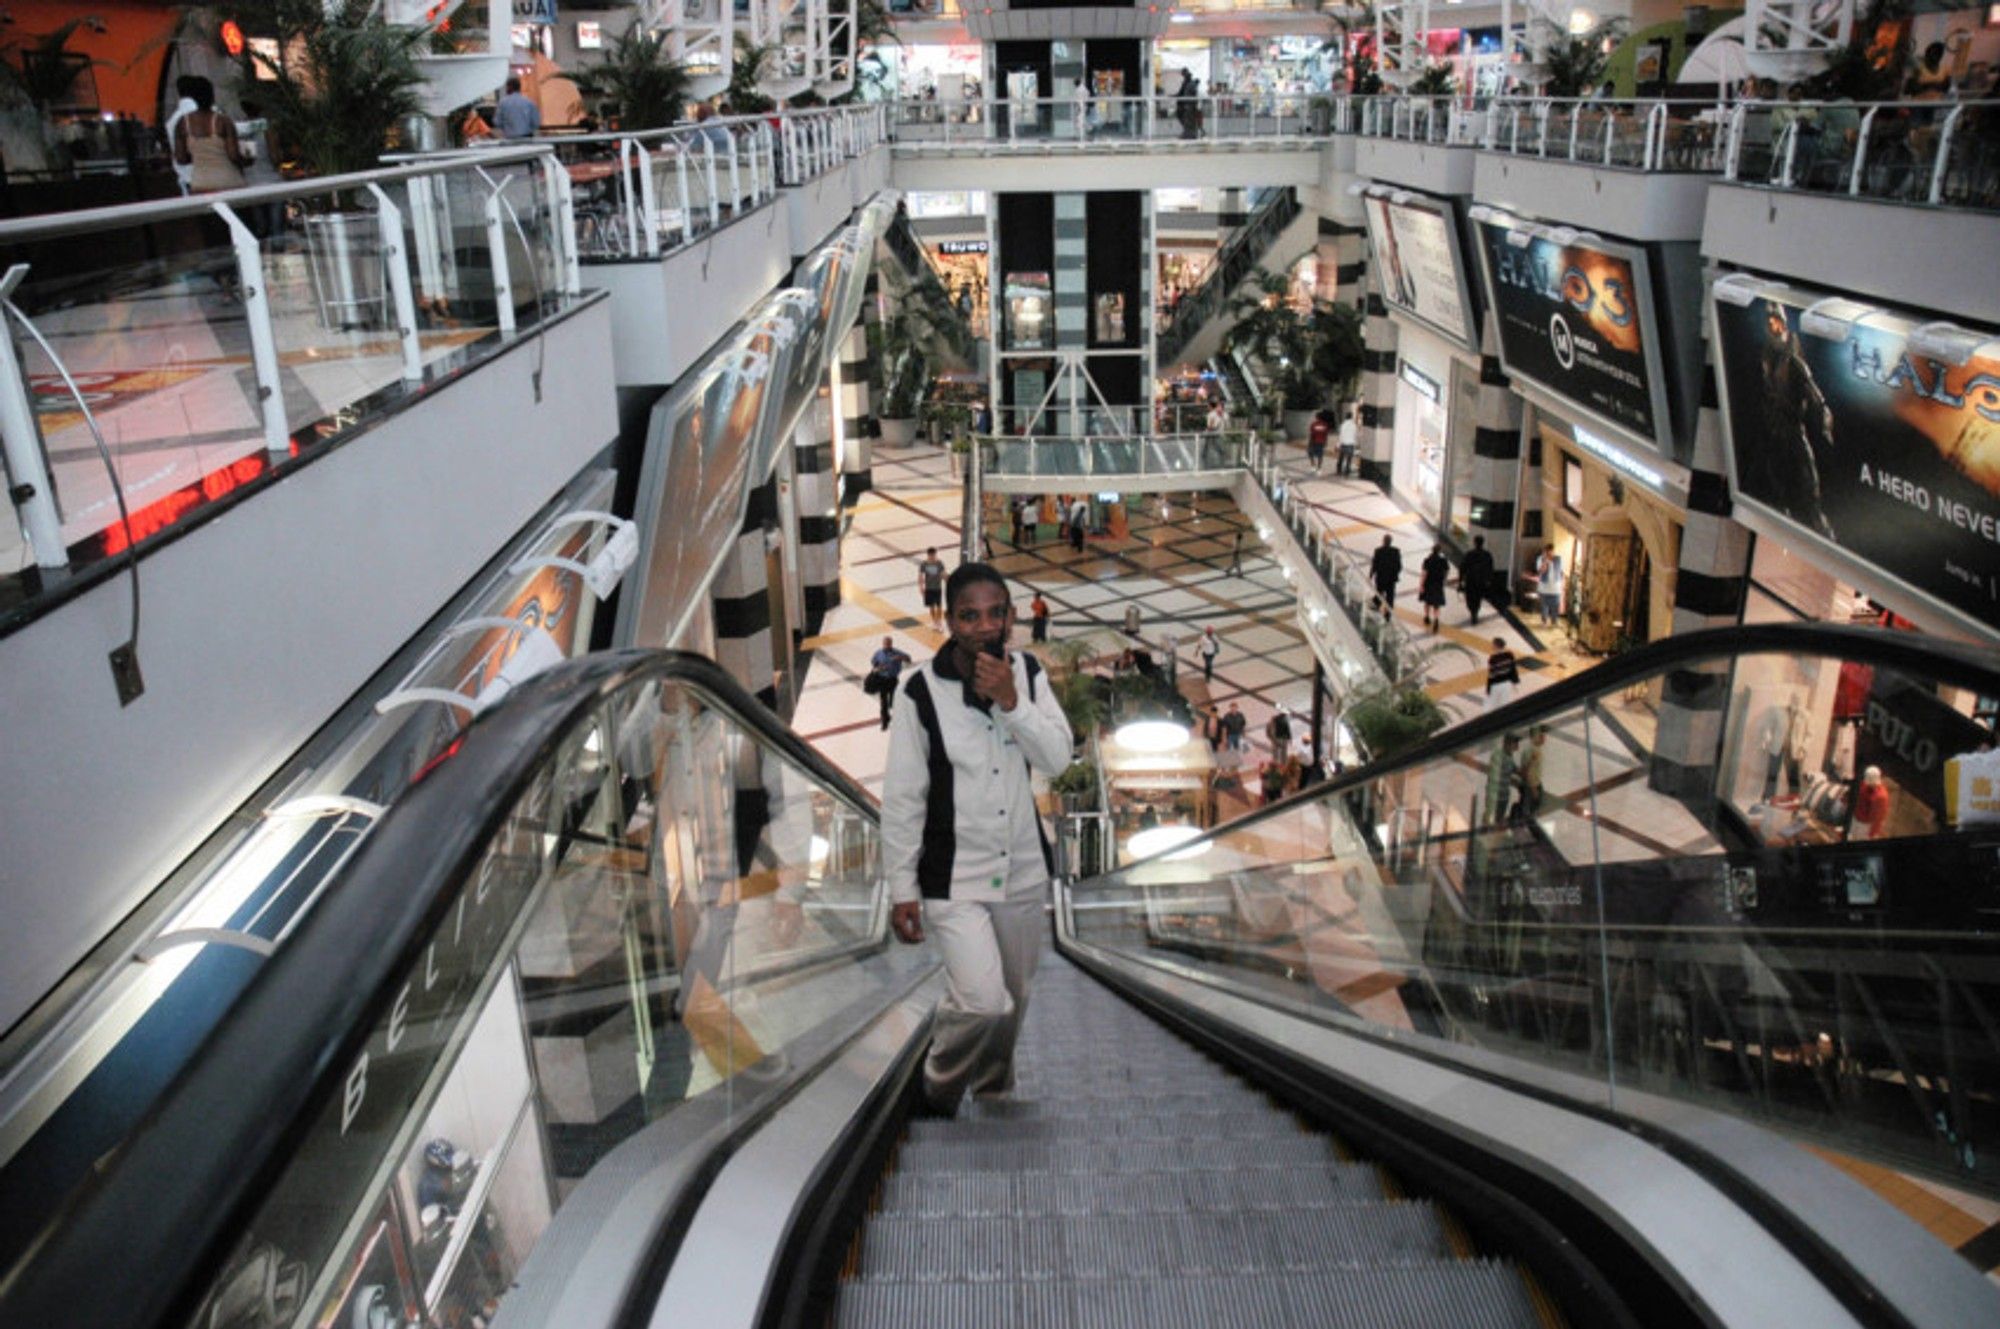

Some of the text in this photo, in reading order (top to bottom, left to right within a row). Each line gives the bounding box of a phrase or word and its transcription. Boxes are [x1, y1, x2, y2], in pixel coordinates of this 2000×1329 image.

[1492, 244, 1597, 313] HALO
[1601, 278, 1632, 328] 3
[1851, 337, 2000, 423] HALO
[1860, 463, 1873, 486] A
[1878, 470, 1930, 512] HERO
